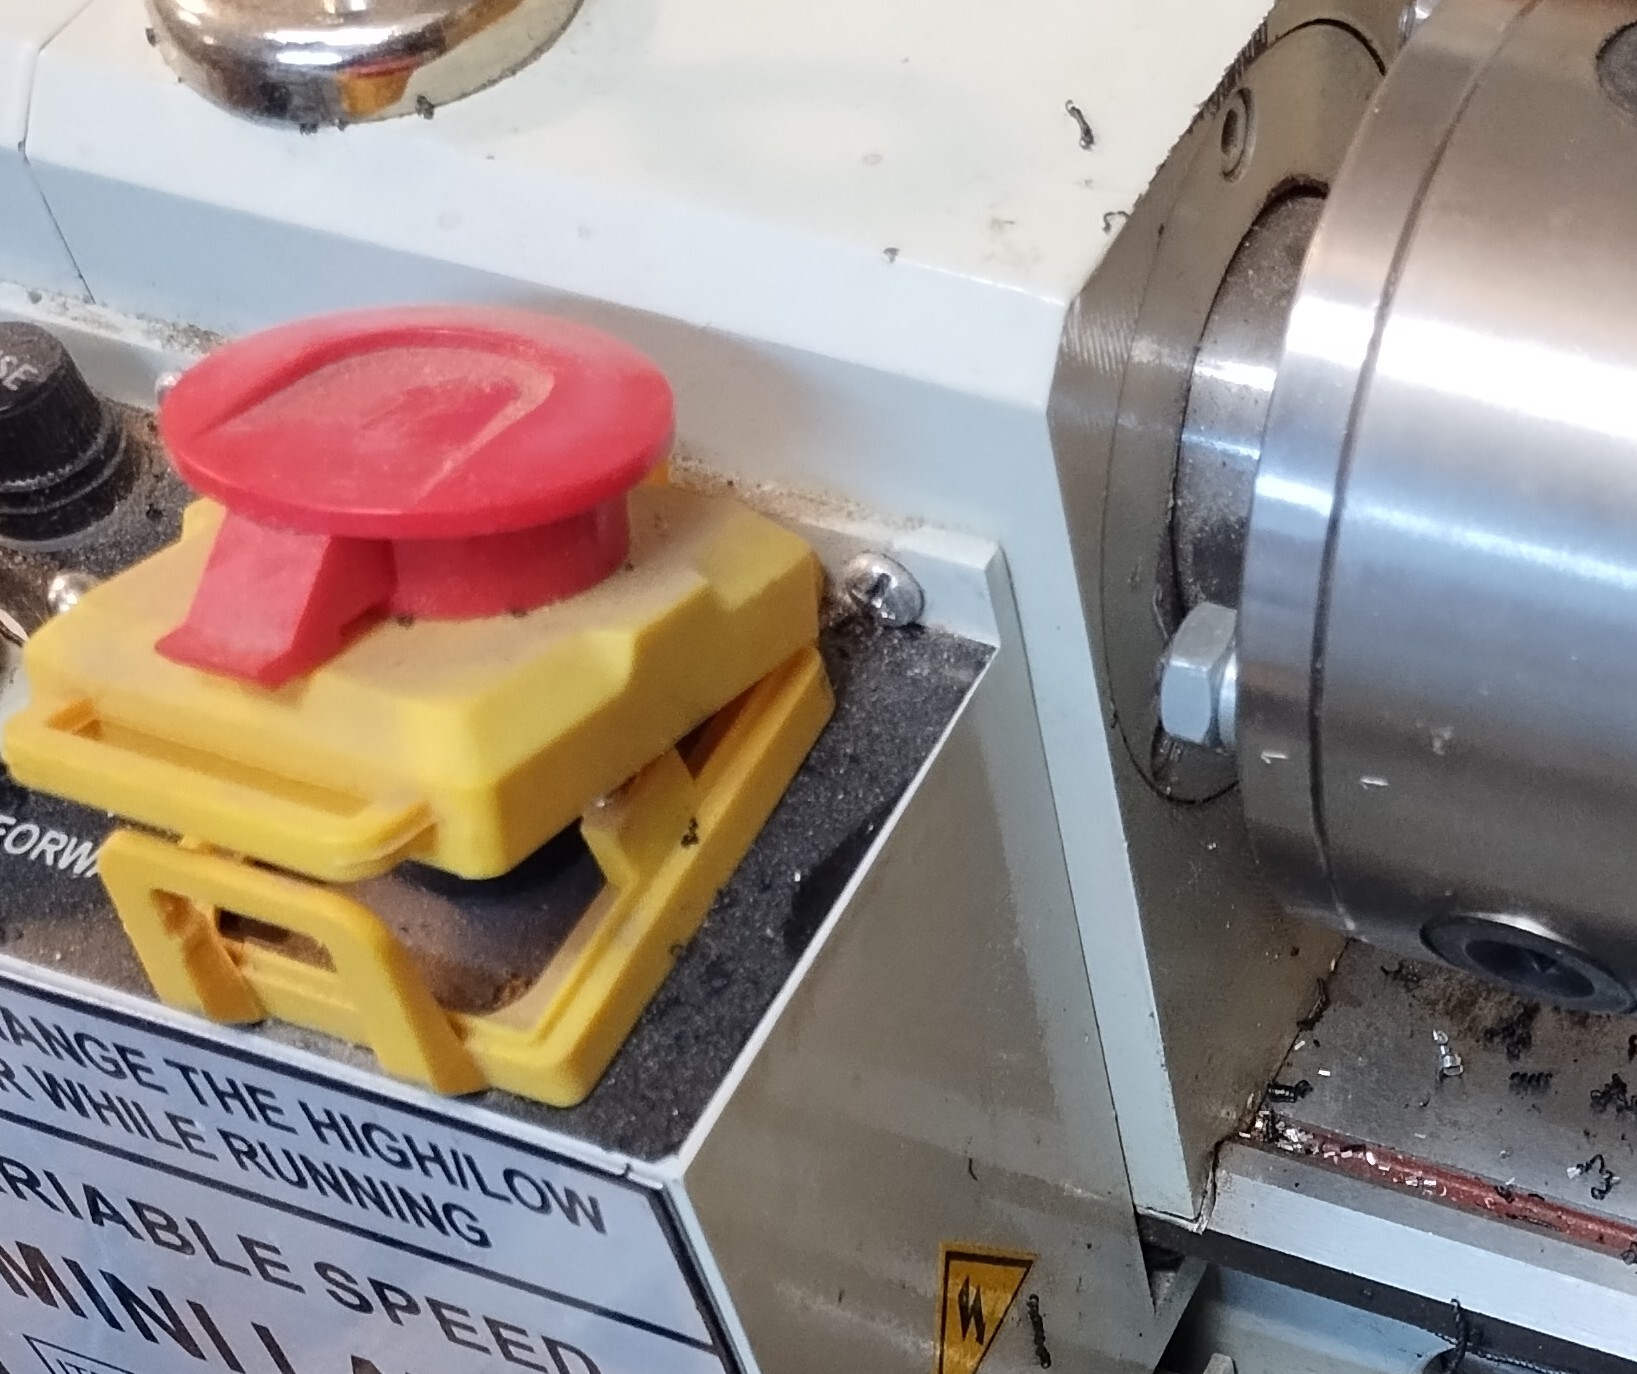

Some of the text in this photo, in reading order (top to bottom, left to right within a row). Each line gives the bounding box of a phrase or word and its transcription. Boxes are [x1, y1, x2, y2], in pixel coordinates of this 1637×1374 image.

[0, 1005, 169, 1095] ANGE
[163, 1057, 299, 1135] THE
[0, 1155, 305, 1294] RIABLE
[23, 1064, 218, 1162] WHILE
[221, 1129, 493, 1249] RUNNING
